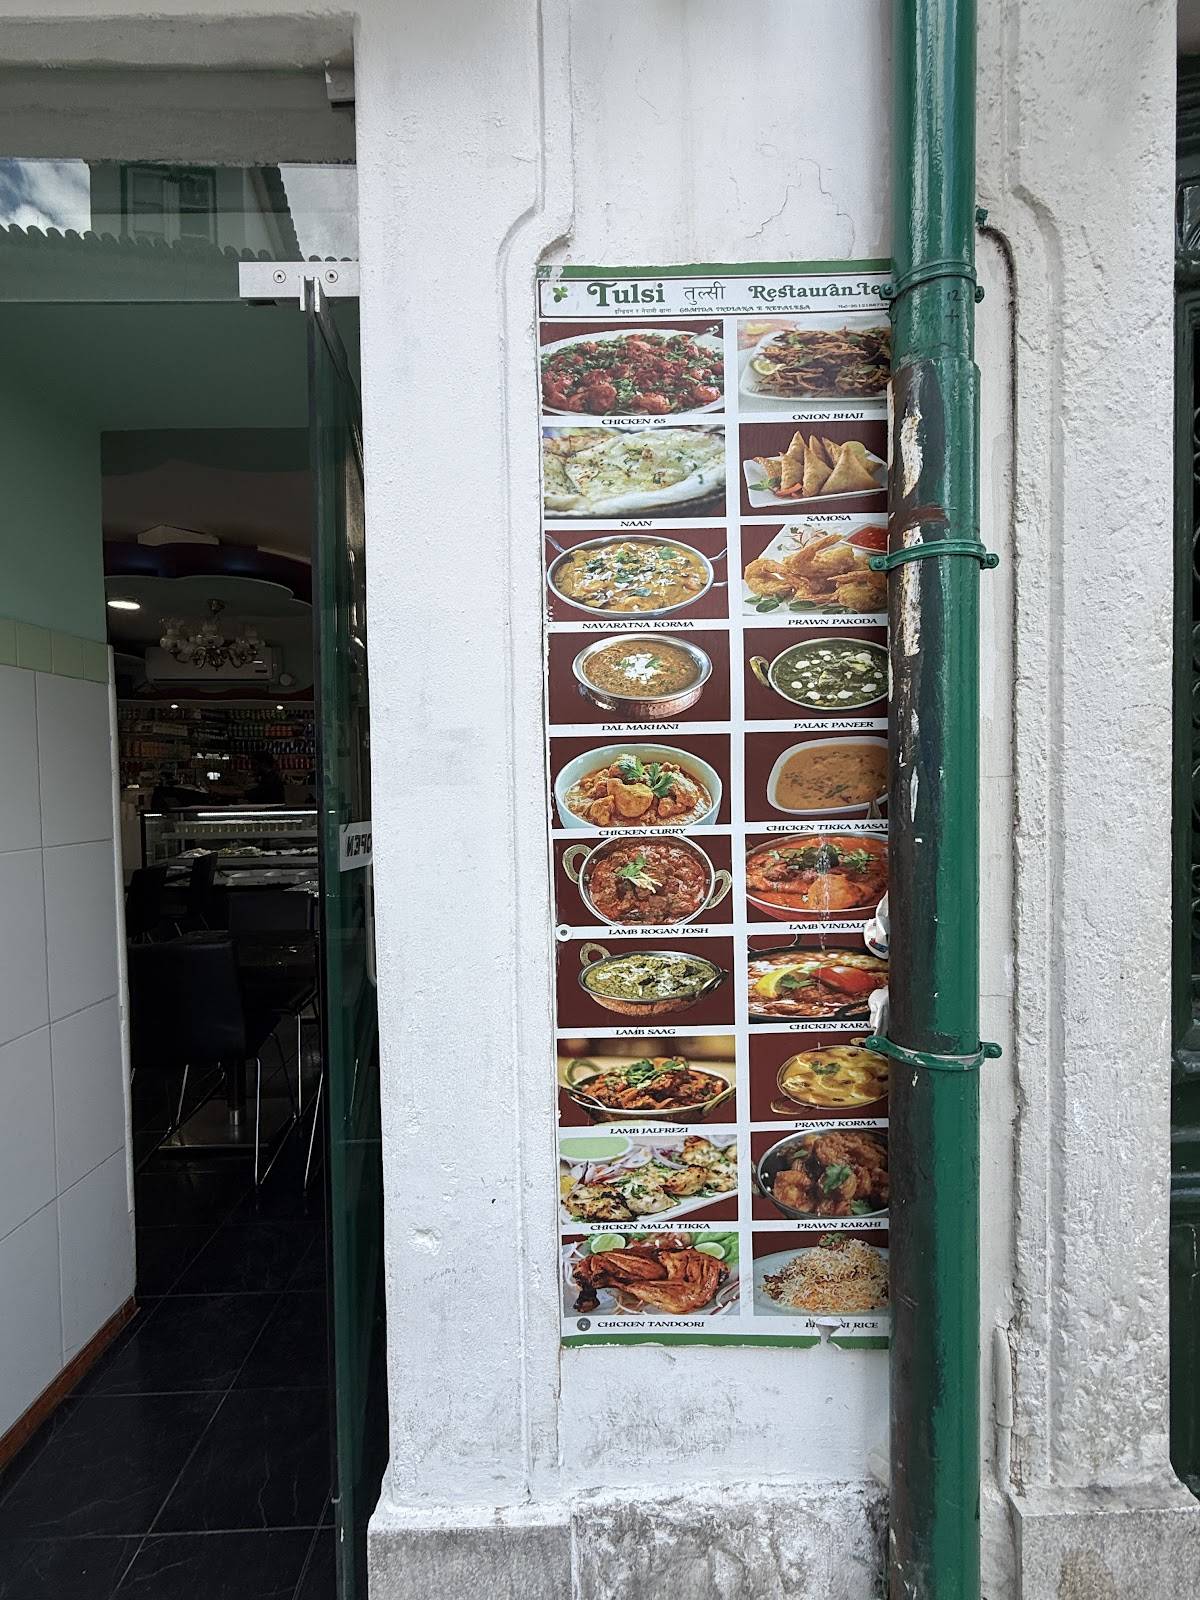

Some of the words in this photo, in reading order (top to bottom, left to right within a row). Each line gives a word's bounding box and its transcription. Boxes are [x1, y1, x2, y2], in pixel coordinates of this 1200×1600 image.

[587, 282, 665, 306] Tulsi
[683, 281, 726, 305] तुल्सी
[748, 282, 880, 302] Restaurante
